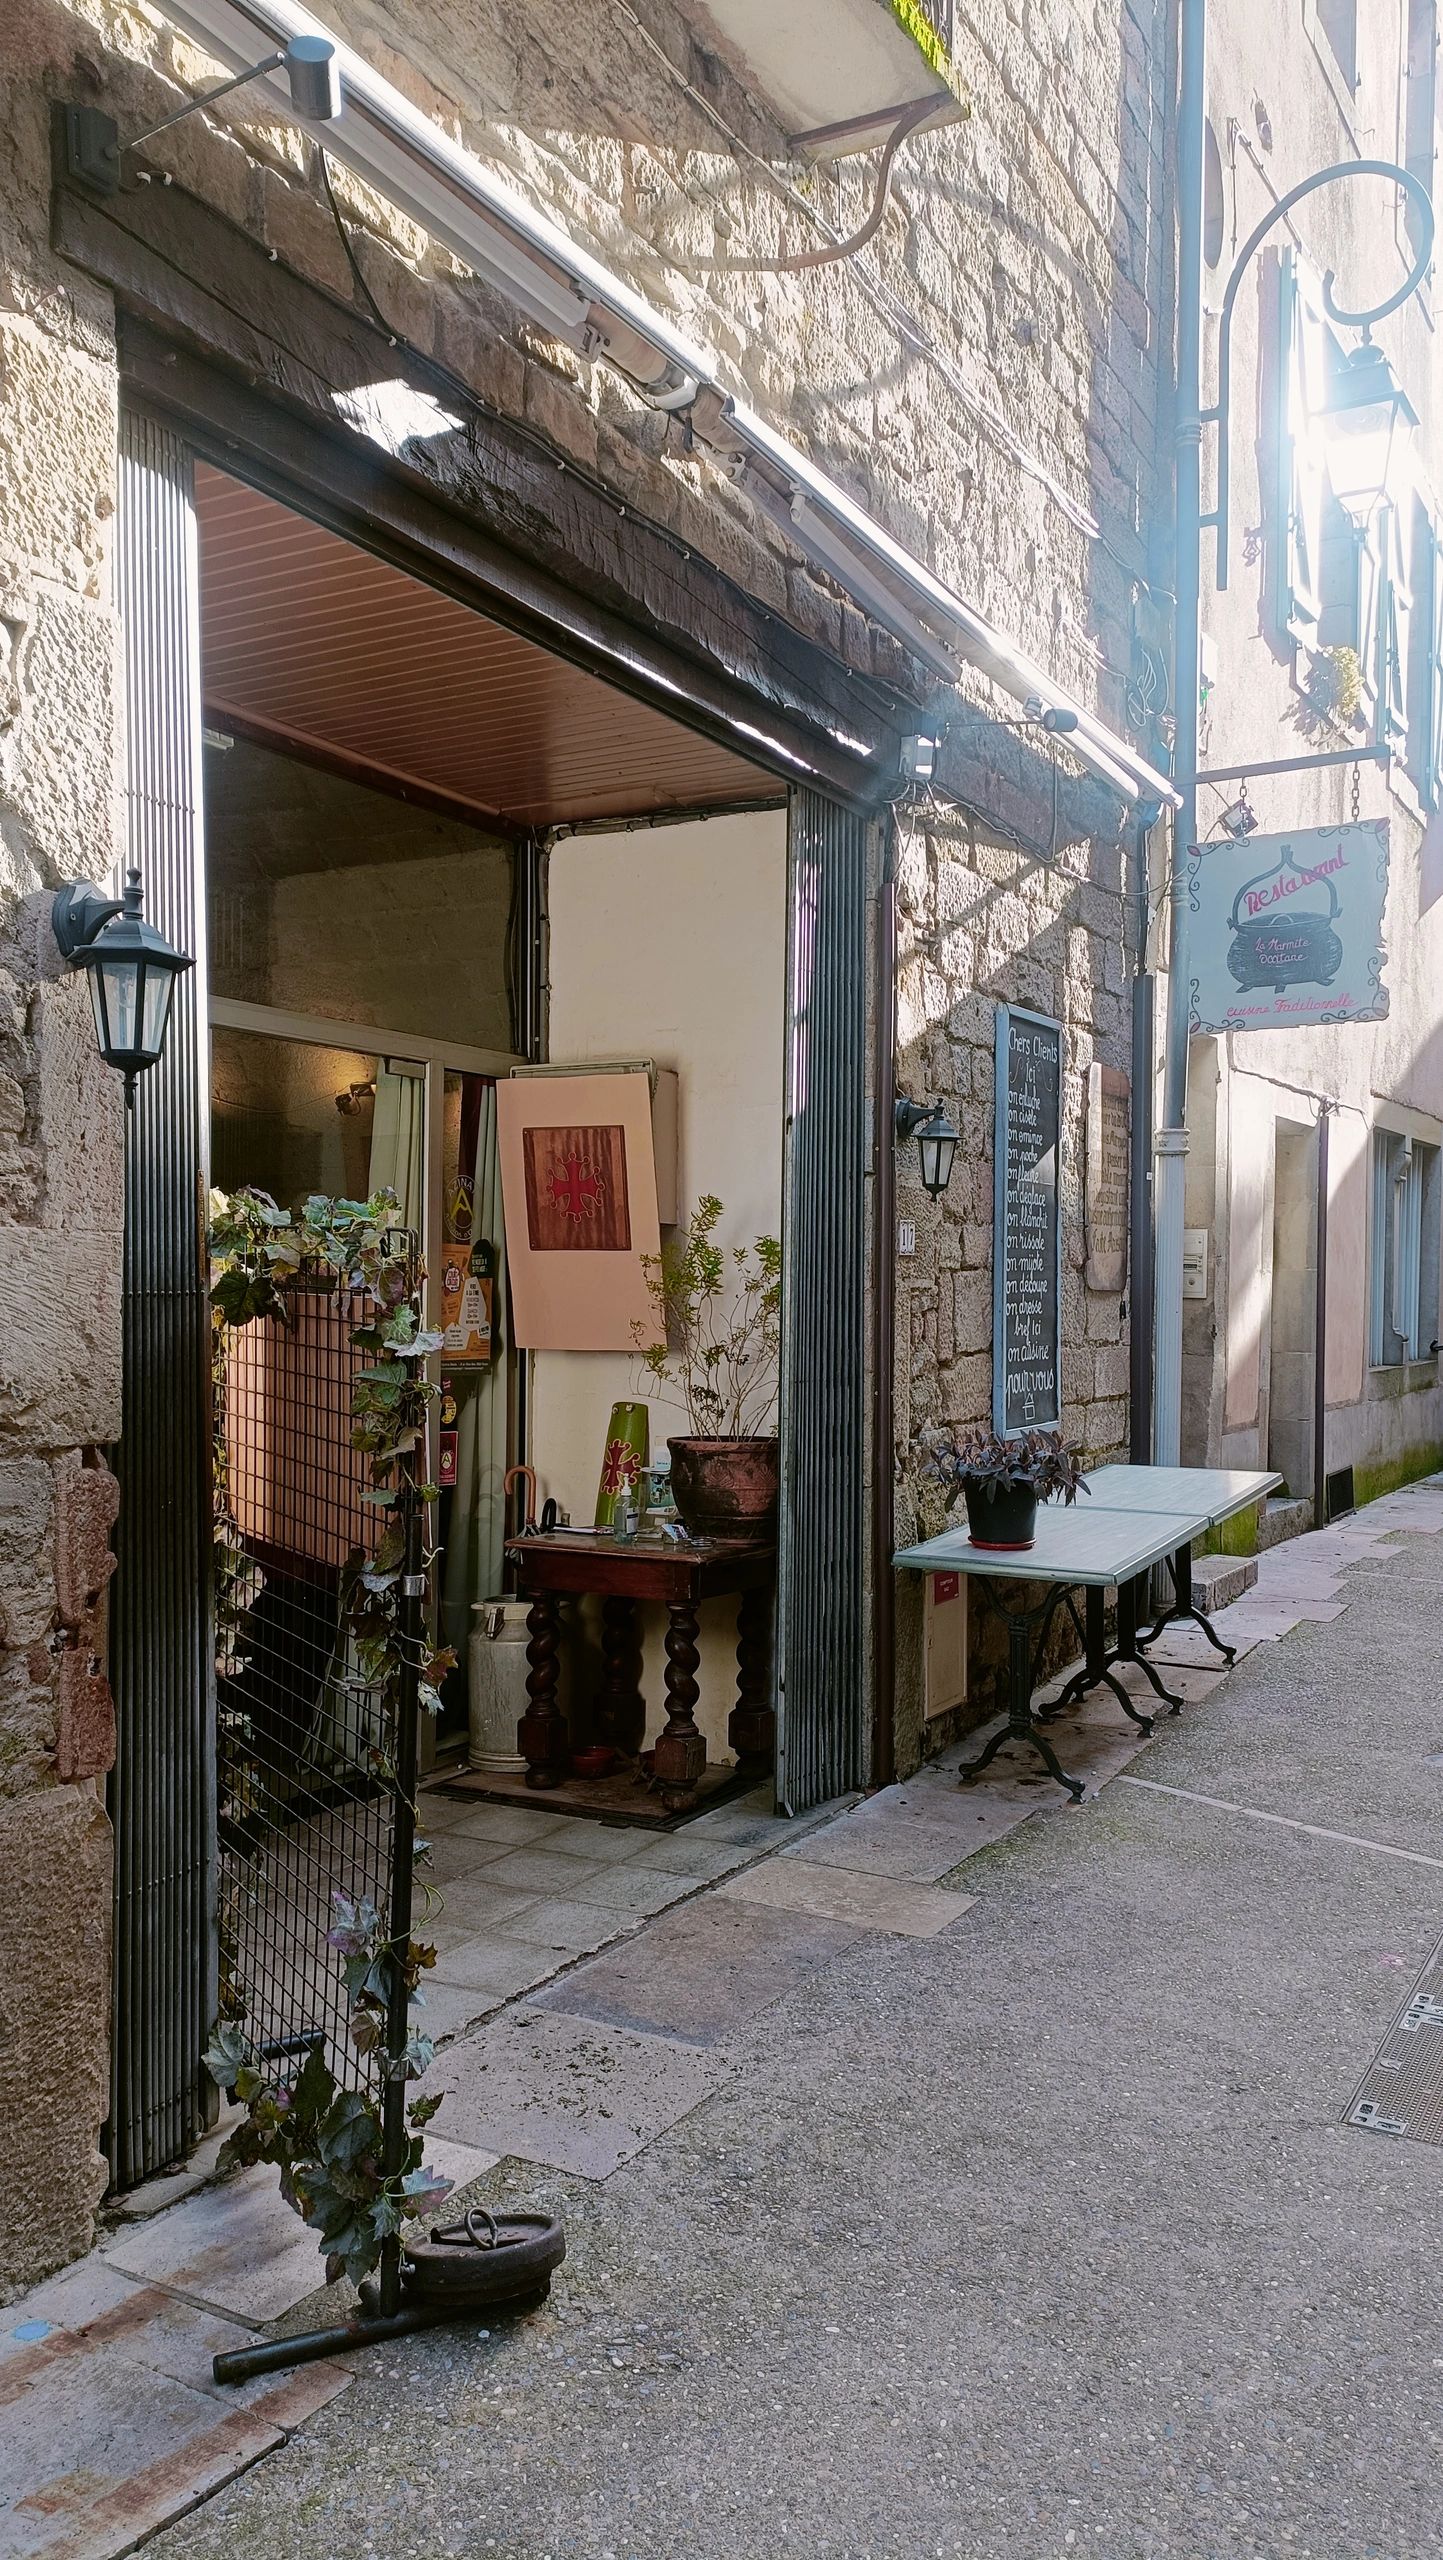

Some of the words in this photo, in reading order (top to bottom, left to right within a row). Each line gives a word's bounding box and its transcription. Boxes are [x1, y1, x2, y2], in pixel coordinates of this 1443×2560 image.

[1243, 843, 1349, 915] Restaurant
[1255, 937, 1265, 953] La
[1268, 936, 1312, 951] Marmite
[1259, 953, 1310, 964] Occitane
[1009, 1027, 1030, 1055] Chers
[1033, 1036, 1057, 1063] Clients
[1026, 1060, 1036, 1083] Ici
[1008, 1090, 1018, 1105] on
[1008, 1109, 1018, 1122] on
[1008, 1128, 1018, 1141] on
[1008, 1148, 1018, 1159] on
[1019, 1145, 1038, 1169] poche
[1007, 1168, 1018, 1180] on
[1007, 1190, 1018, 1203] on
[1019, 1183, 1046, 1215] déglace
[1007, 1213, 1018, 1227] on
[1020, 1204, 1048, 1229] blanchit
[1007, 1235, 1018, 1248] on
[1019, 1229, 1045, 1250] rissole
[1006, 1257, 1018, 1271] on
[1018, 1250, 1044, 1281] mijote
[1006, 1280, 1018, 1294] on
[1019, 1272, 1047, 1300] découpe
[1006, 1303, 1018, 1315] on
[1019, 1293, 1043, 1314] dresse
[1013, 1315, 1030, 1346] bref
[1008, 1347, 1020, 1362] on
[1021, 1341, 1049, 1361] cuisine
[1006, 1370, 1030, 1410] pour
[1030, 1368, 1054, 1391] vous
